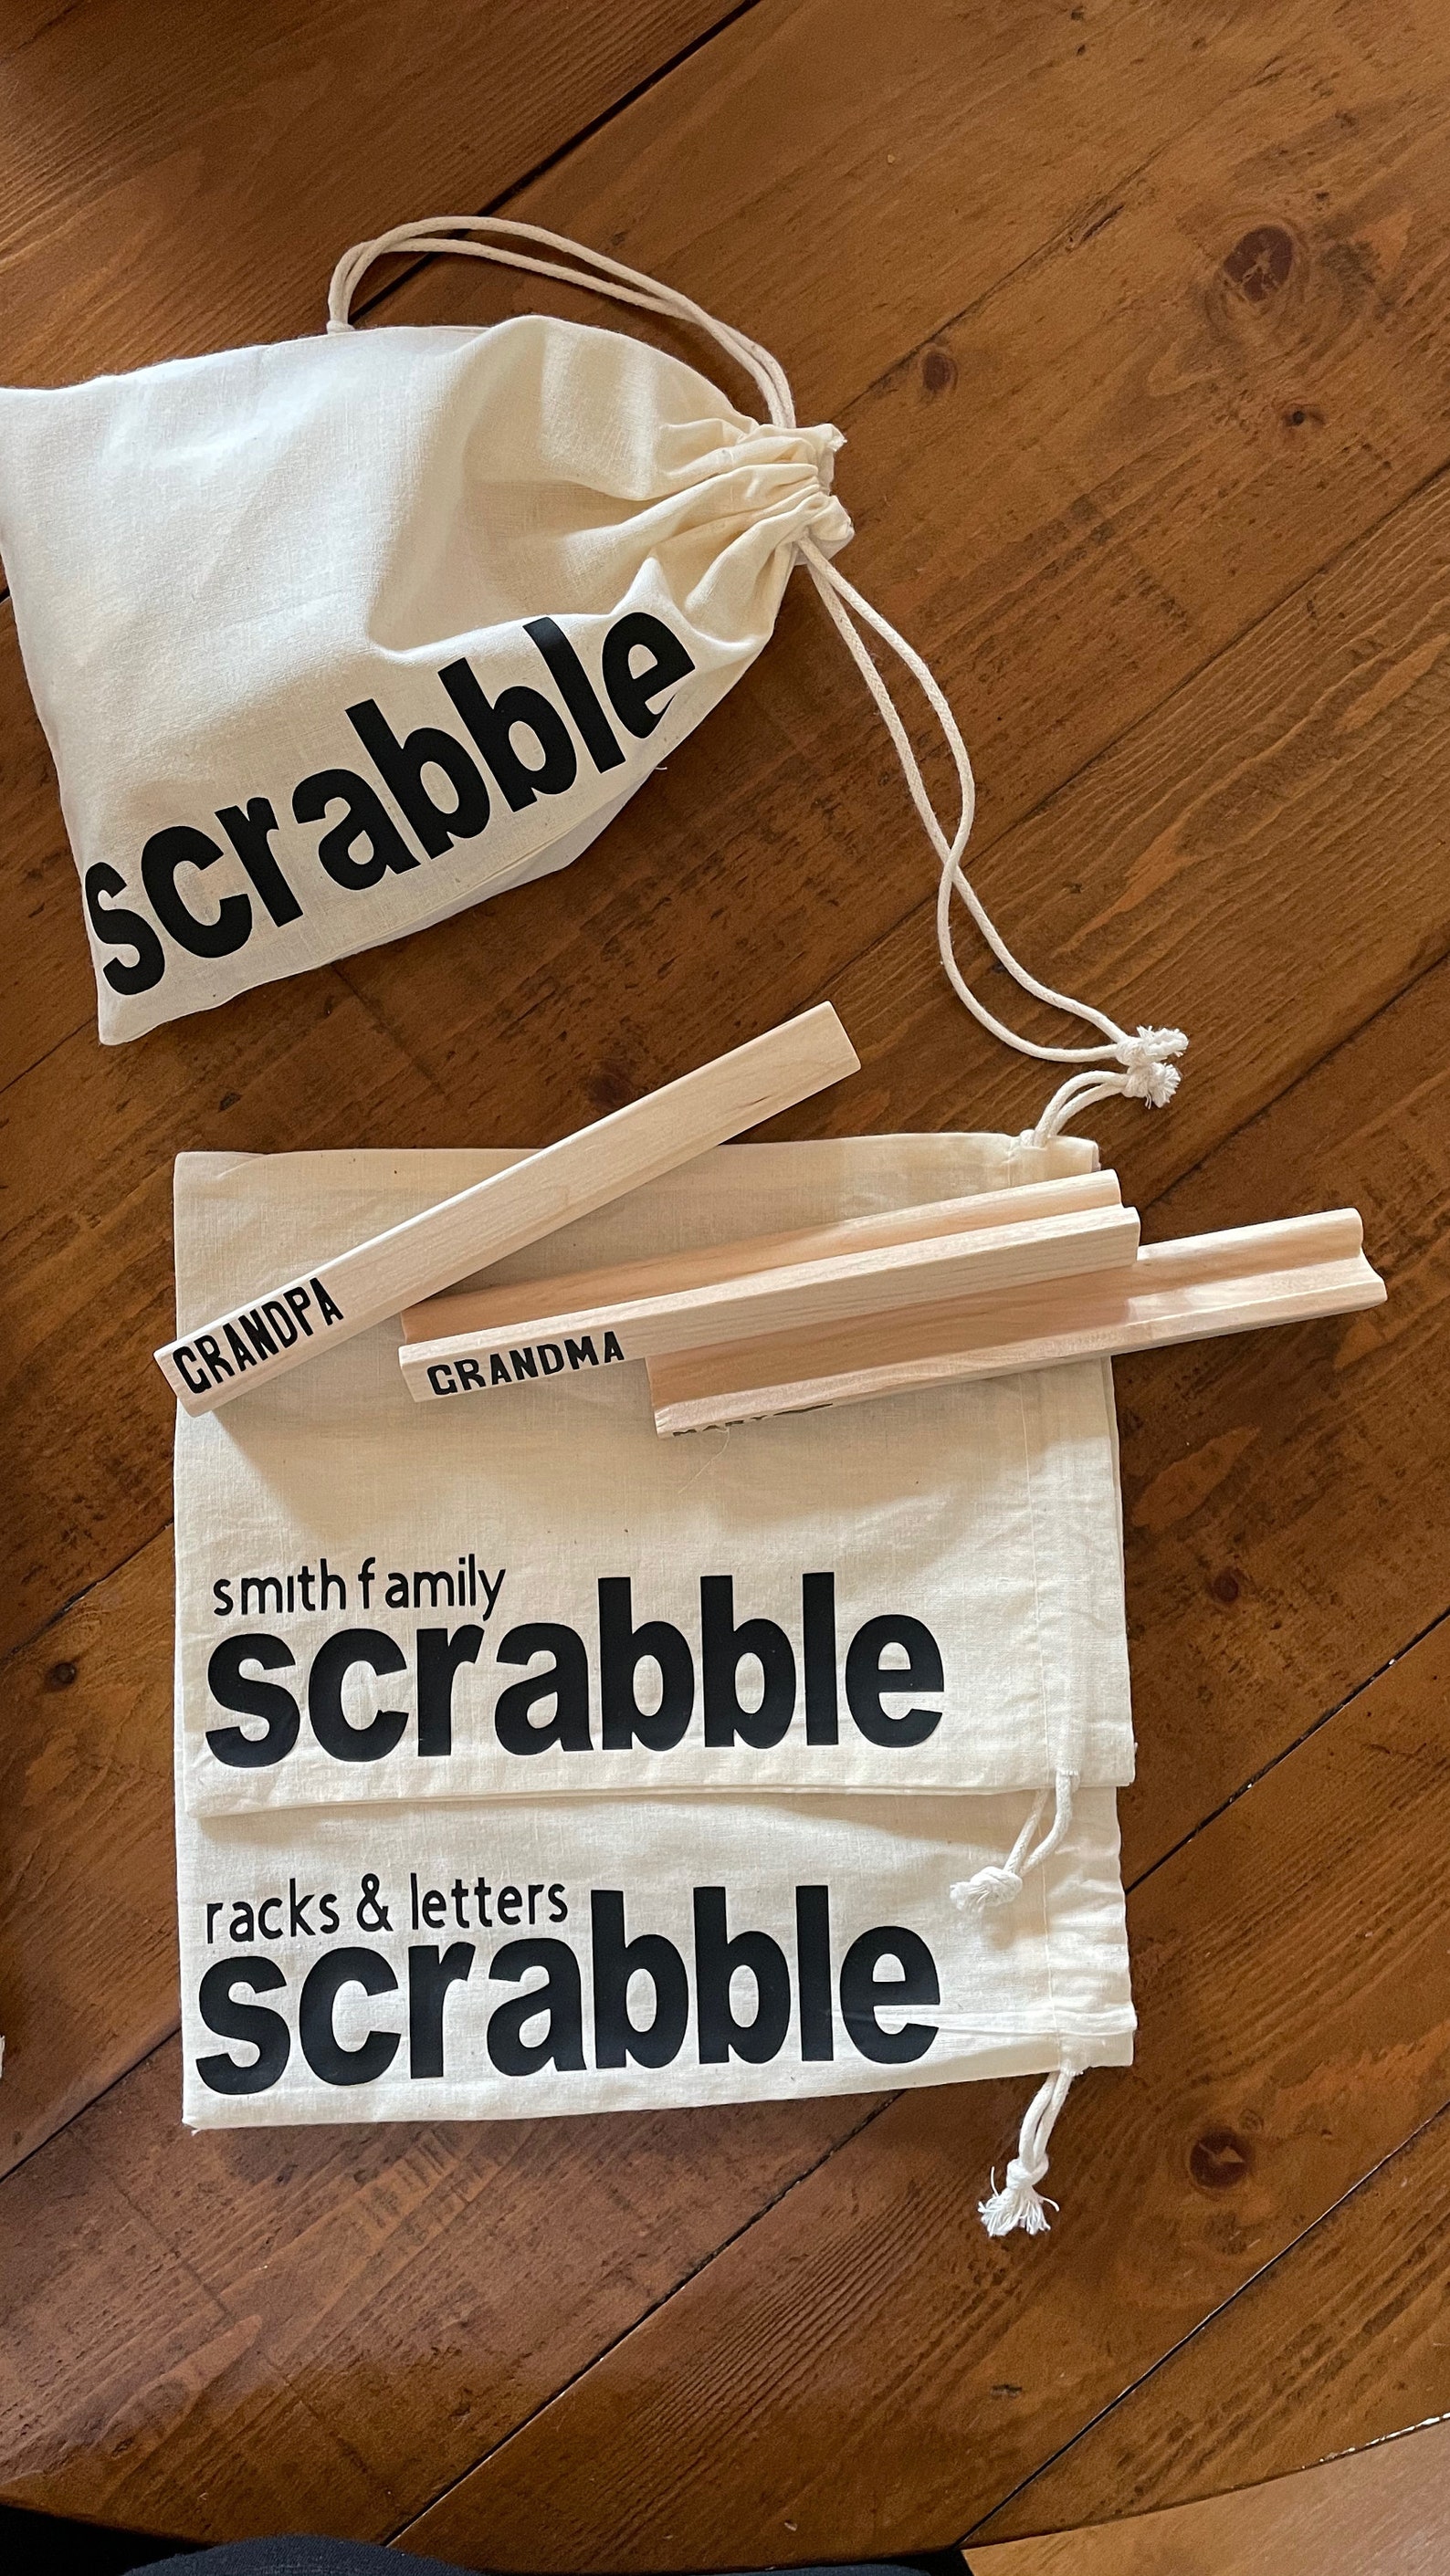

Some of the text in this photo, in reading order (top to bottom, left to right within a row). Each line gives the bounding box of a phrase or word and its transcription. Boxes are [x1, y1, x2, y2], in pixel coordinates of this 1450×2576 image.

[84, 611, 697, 997] scrabble
[172, 1276, 345, 1395] GRANDPA
[426, 1330, 625, 1397] GRANDMA
[213, 1553, 507, 1622] smith family
[205, 1571, 944, 1768] scrabble
[206, 1872, 568, 1945] racks & letters
[195, 1884, 940, 2096] scrabble
